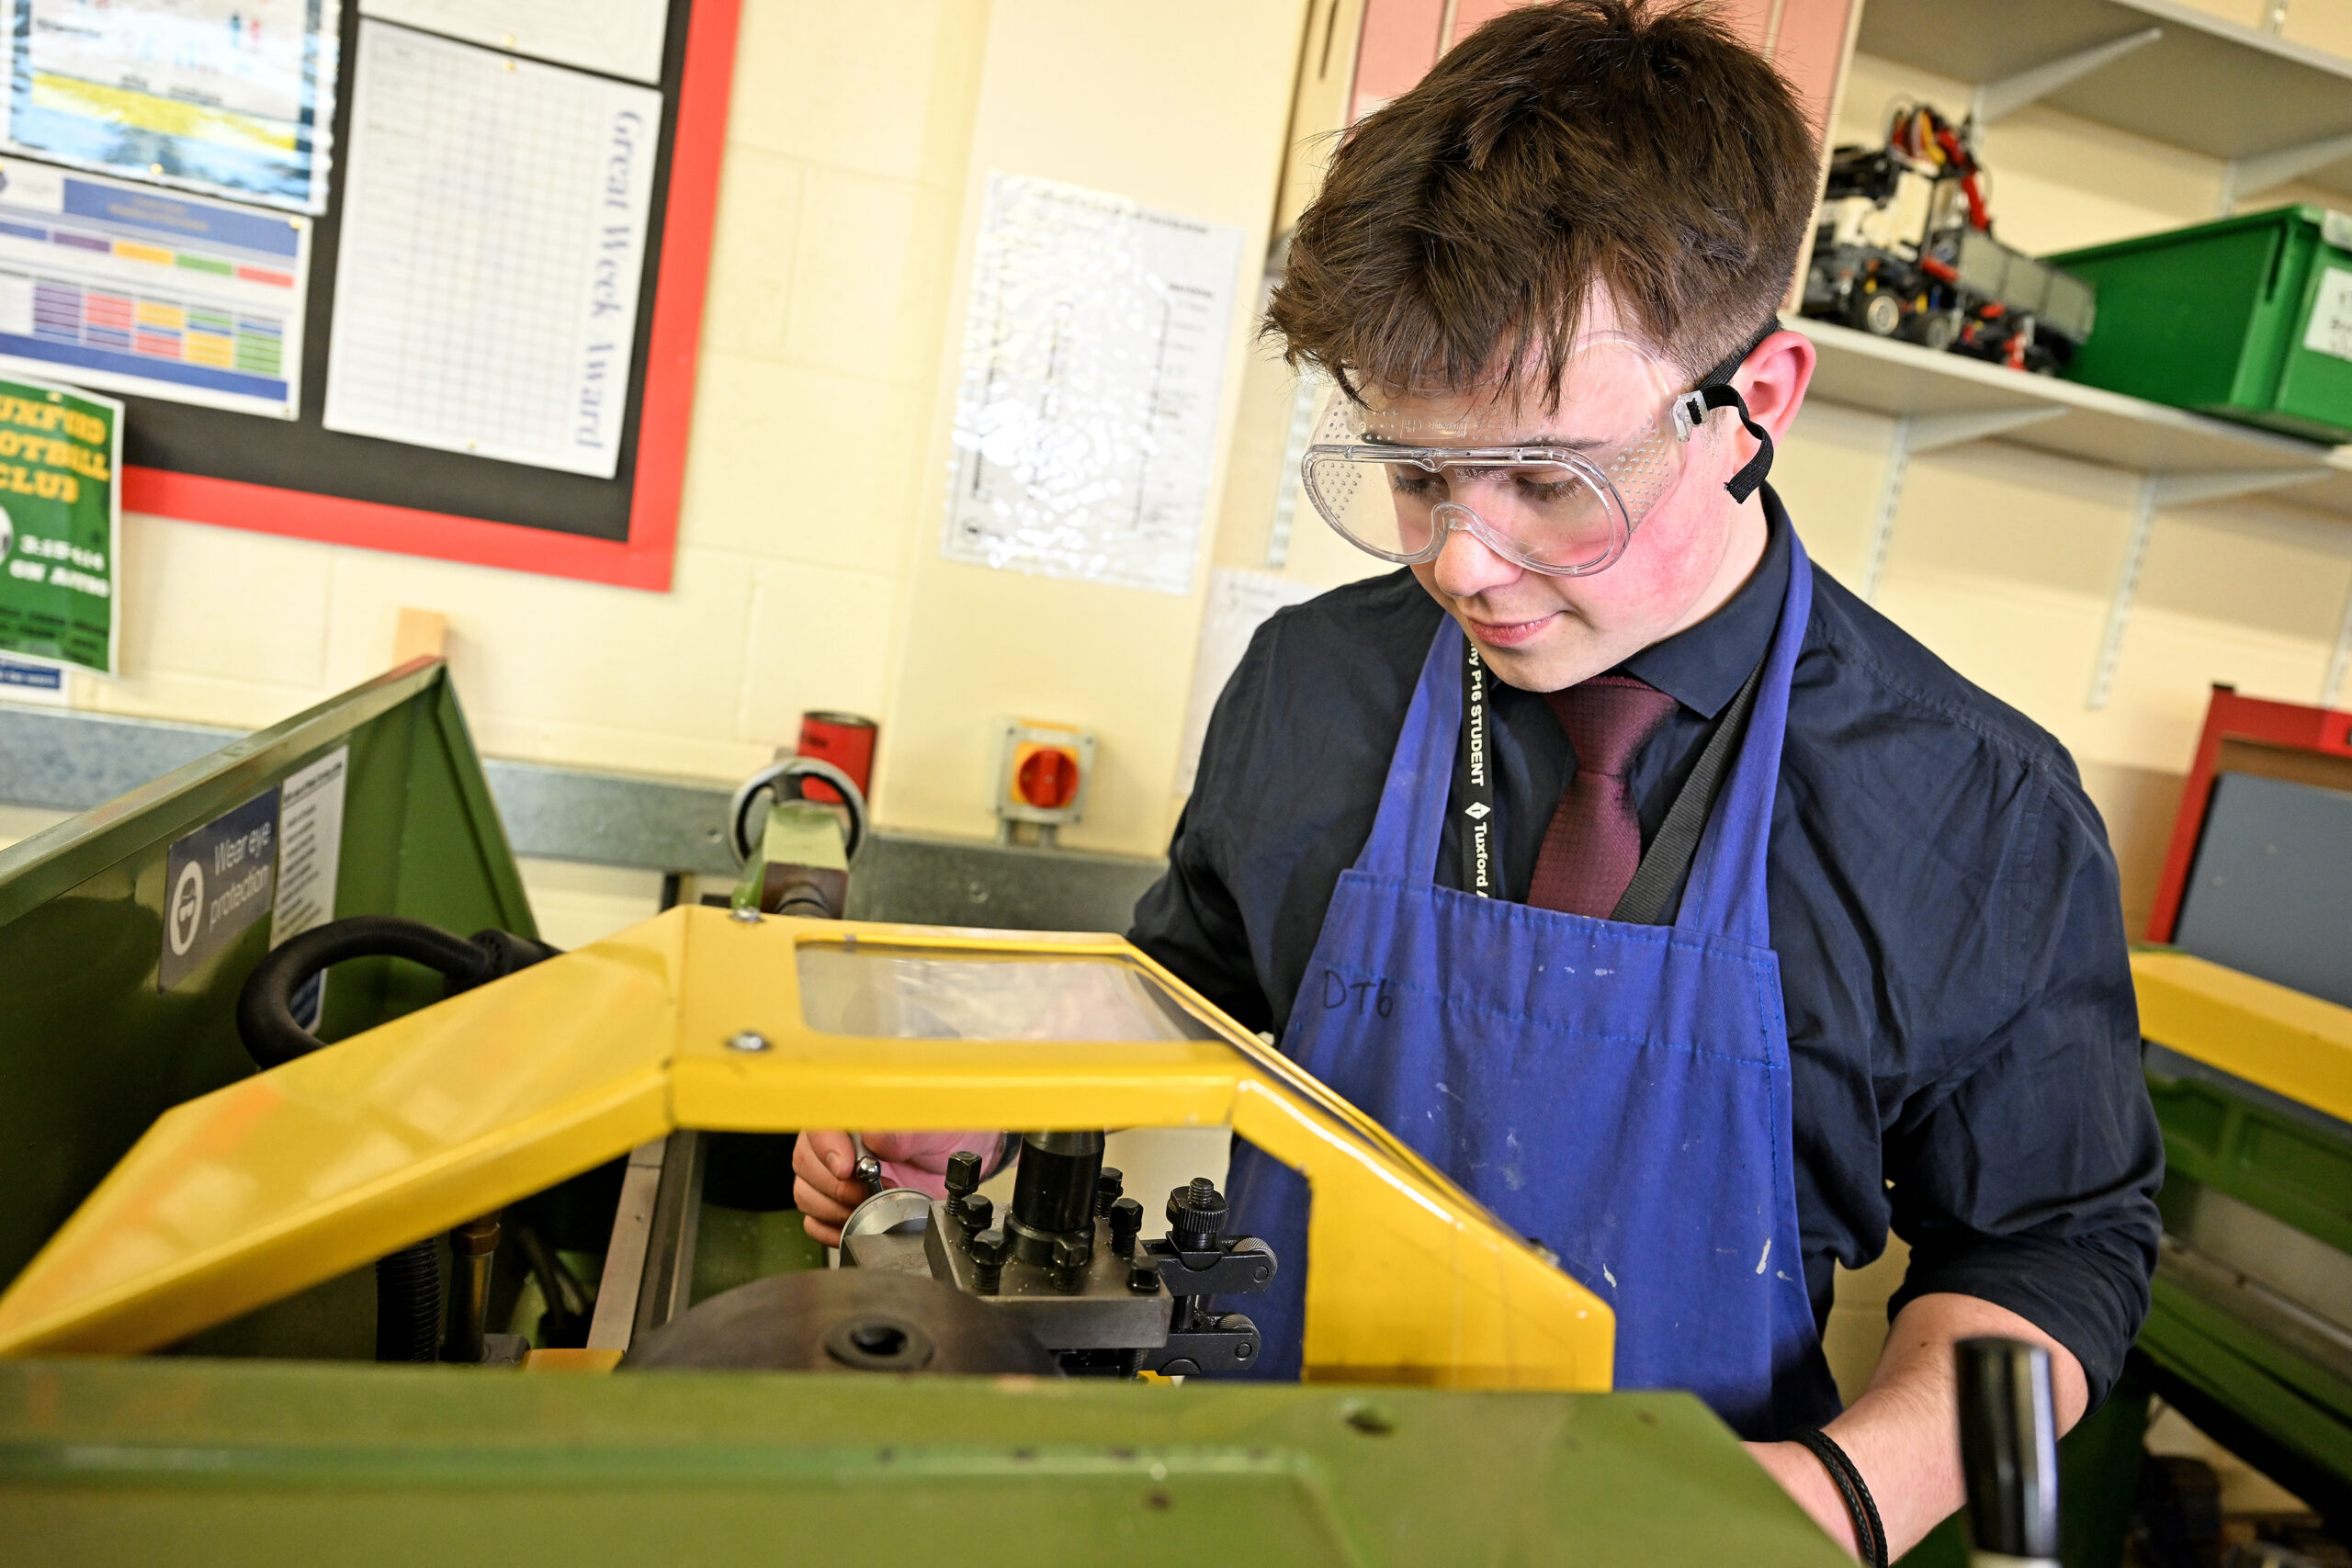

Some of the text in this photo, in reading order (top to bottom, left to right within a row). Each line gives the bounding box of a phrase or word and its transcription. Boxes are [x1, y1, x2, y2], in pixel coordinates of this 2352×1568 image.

[574, 110, 645, 449] Great Week Award
[1471, 670, 1483, 702] P16
[1470, 704, 1484, 787] STUDENT
[214, 820, 272, 877] Wear eye
[1474, 821, 1488, 887] Tuxford
[209, 864, 270, 934] protection
